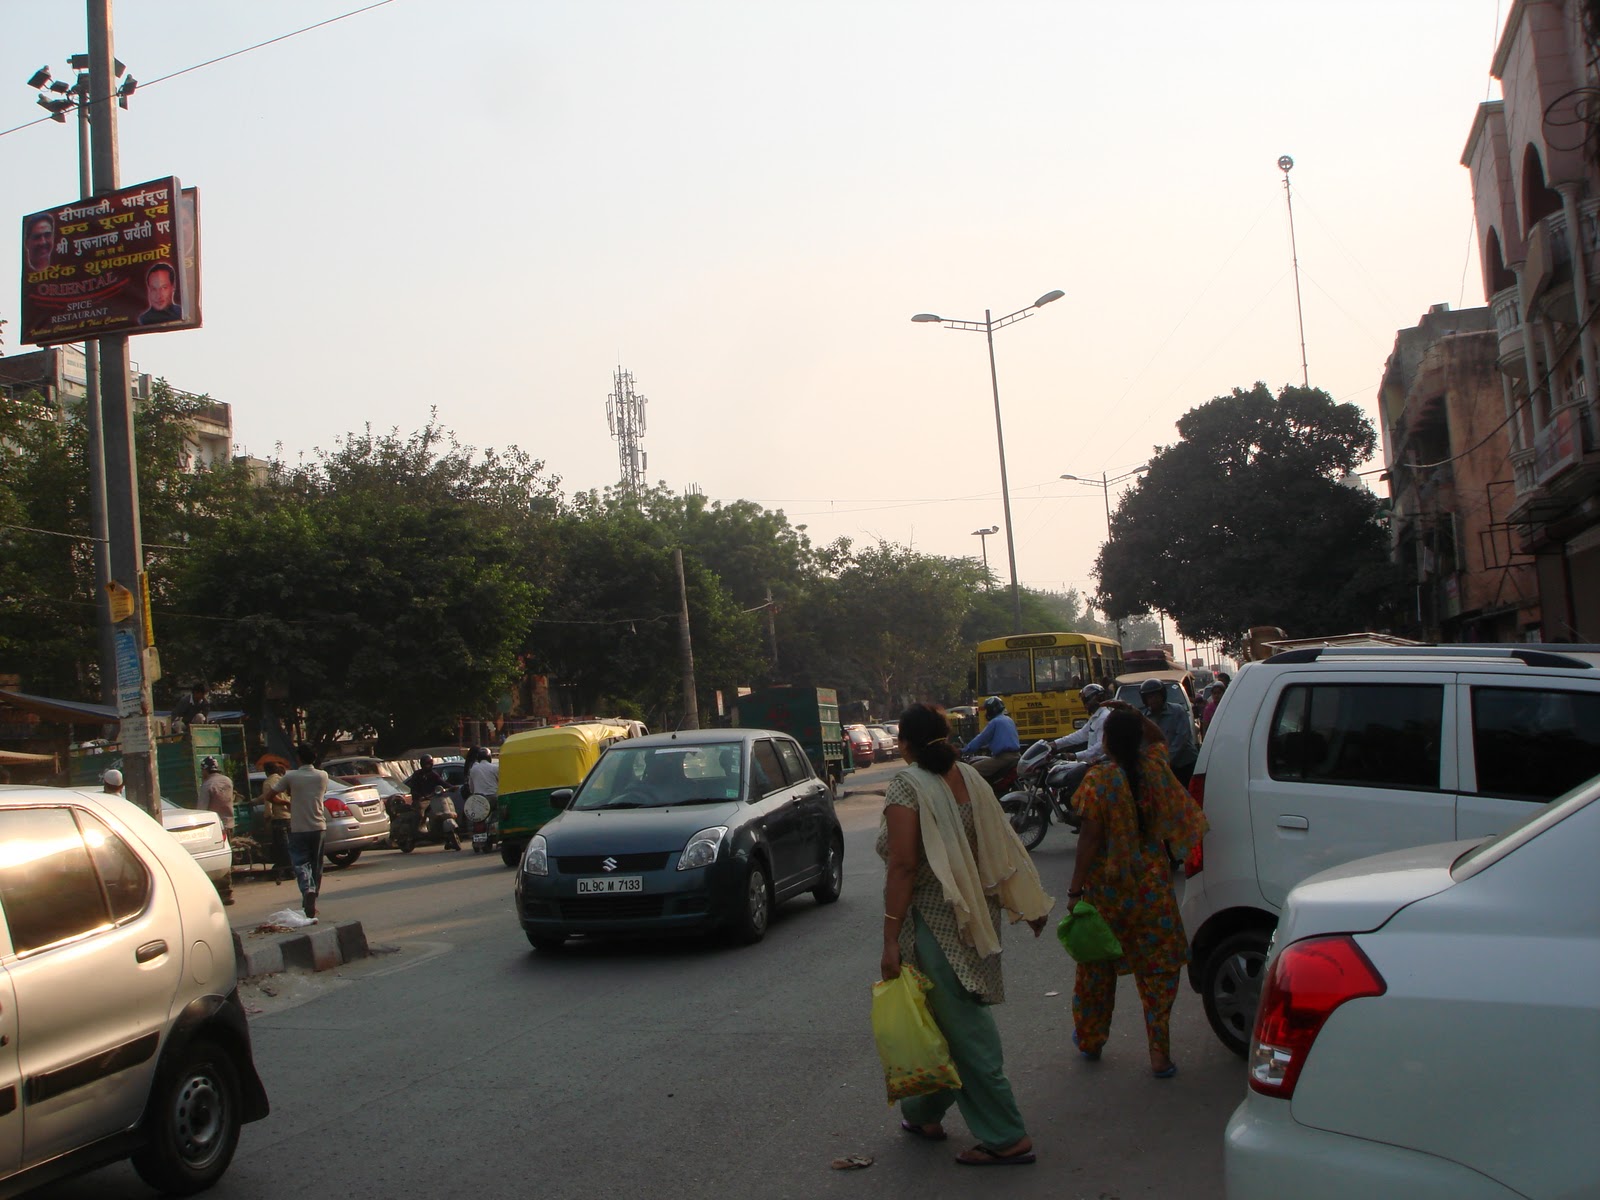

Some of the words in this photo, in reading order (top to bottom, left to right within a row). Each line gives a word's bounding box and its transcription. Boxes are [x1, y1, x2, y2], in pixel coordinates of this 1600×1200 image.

[58, 200, 115, 222] दीपावली,
[121, 188, 169, 208] भाईदूज
[59, 222, 90, 236] छठ
[98, 211, 135, 230] पूजा
[144, 201, 170, 219] एवं
[56, 238, 68, 256] श्री
[157, 220, 171, 234] पर
[27, 262, 76, 284] हार्दिक
[37, 272, 118, 296] ORIENTAL
[51, 307, 109, 324] RESTAURANT
[67, 300, 93, 312] SPICE
[579, 881, 604, 892] DL9C
[618, 879, 640, 891] 7133
